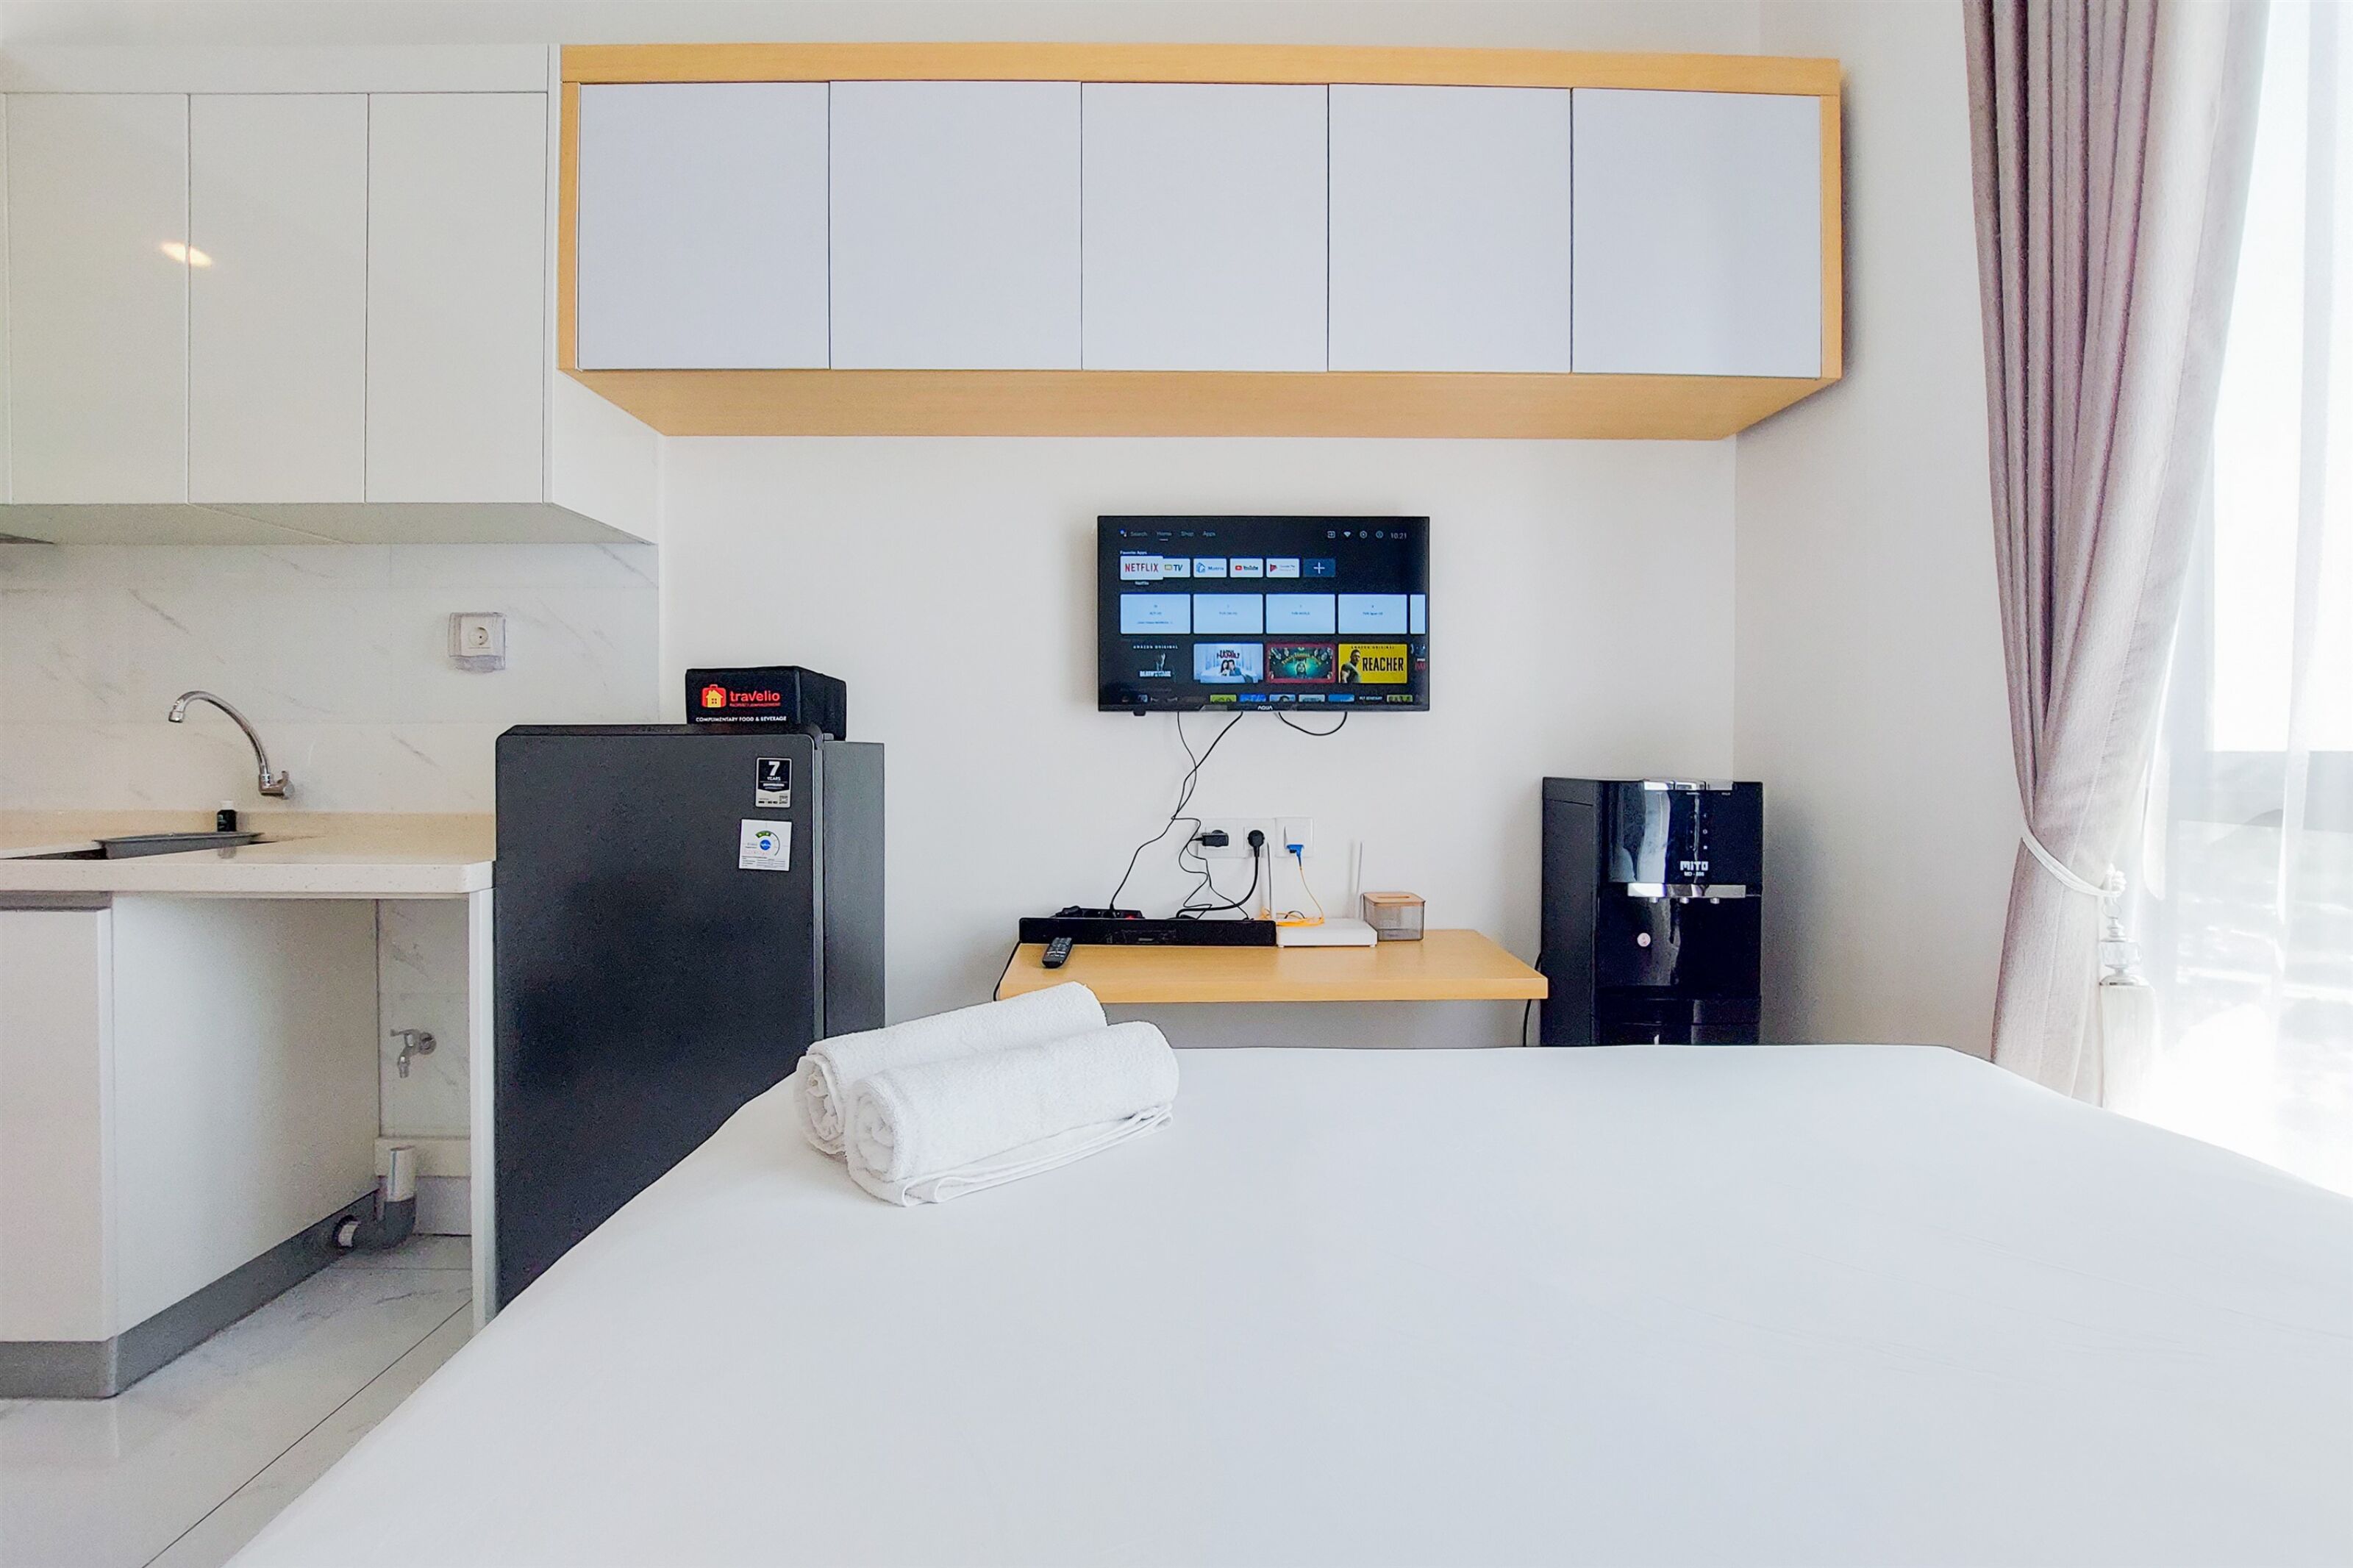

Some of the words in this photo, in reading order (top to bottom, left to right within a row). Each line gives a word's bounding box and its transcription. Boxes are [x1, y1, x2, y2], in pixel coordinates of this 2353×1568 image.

[1124, 563, 1159, 573] NETFLIX
[1173, 564, 1183, 572] TV
[1362, 656, 1404, 672] REACHER
[729, 690, 781, 702] travelio
[768, 761, 780, 776] 7
